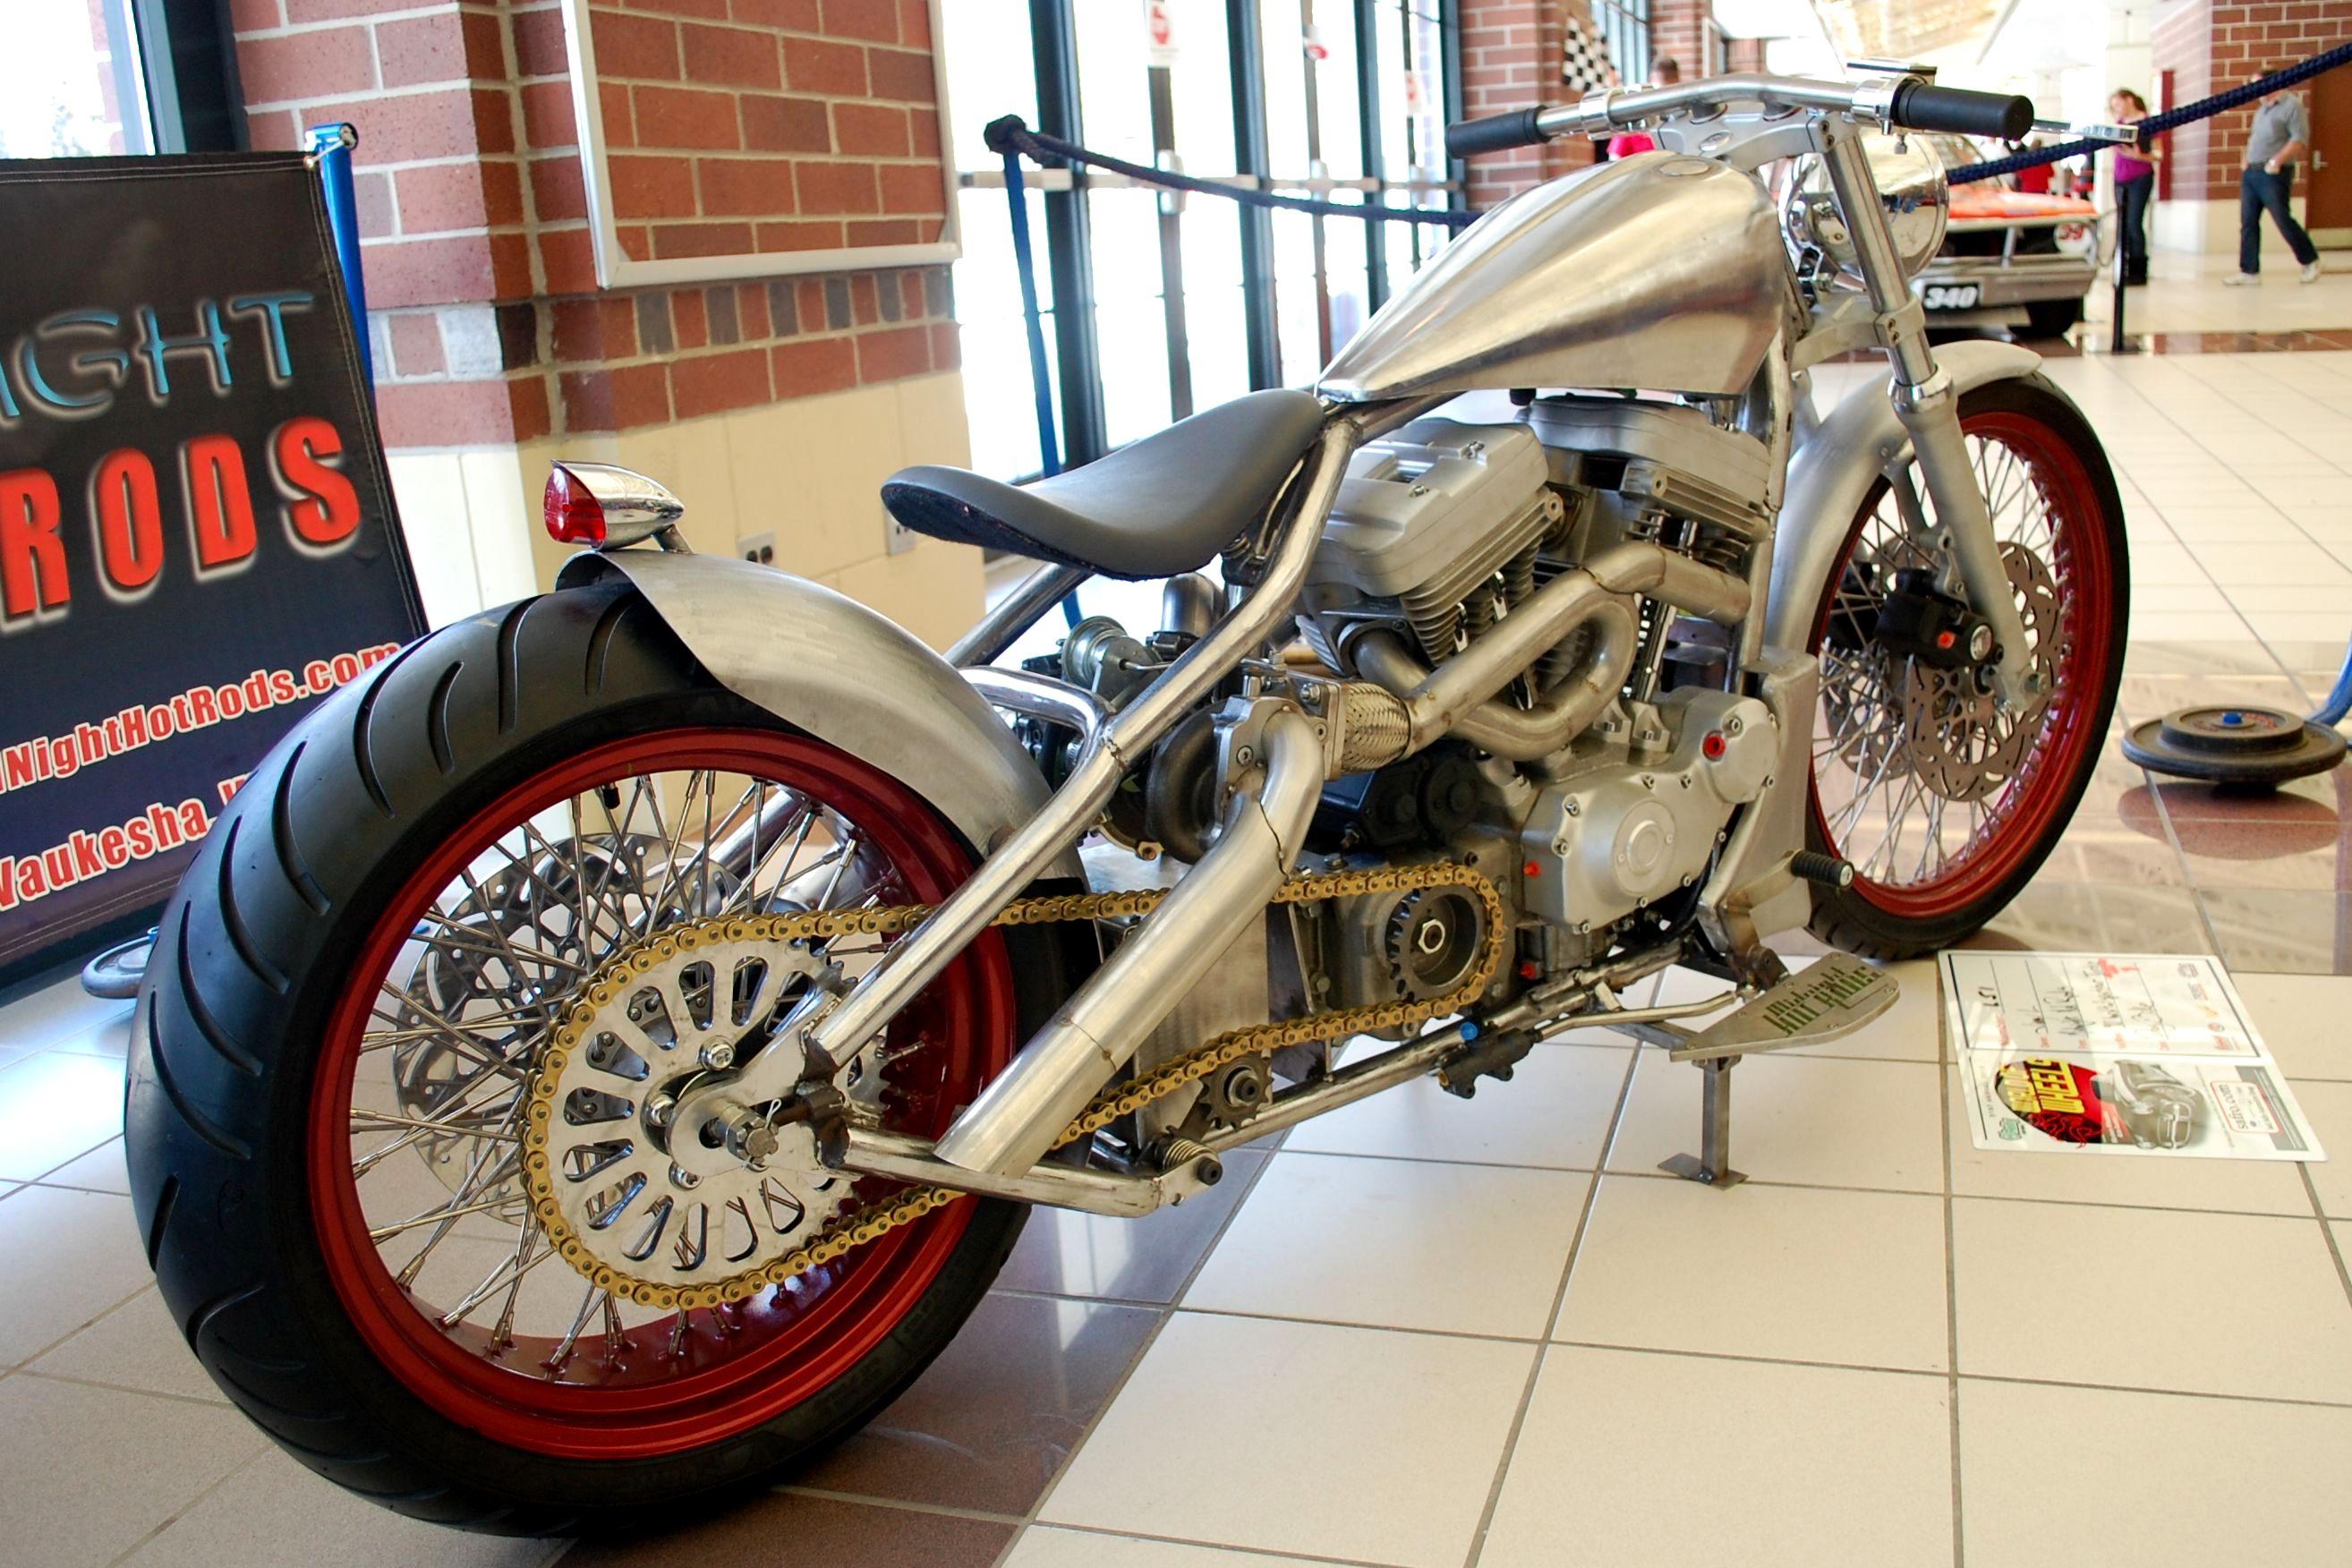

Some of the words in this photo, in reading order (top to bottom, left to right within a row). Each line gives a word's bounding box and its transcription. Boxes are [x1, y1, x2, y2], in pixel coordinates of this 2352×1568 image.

[1924, 285, 1977, 310] 340
[0, 416, 360, 625] RODS
[0, 642, 400, 794] NightHotRods.com
[2025, 1055, 2084, 1114] WHEELS
